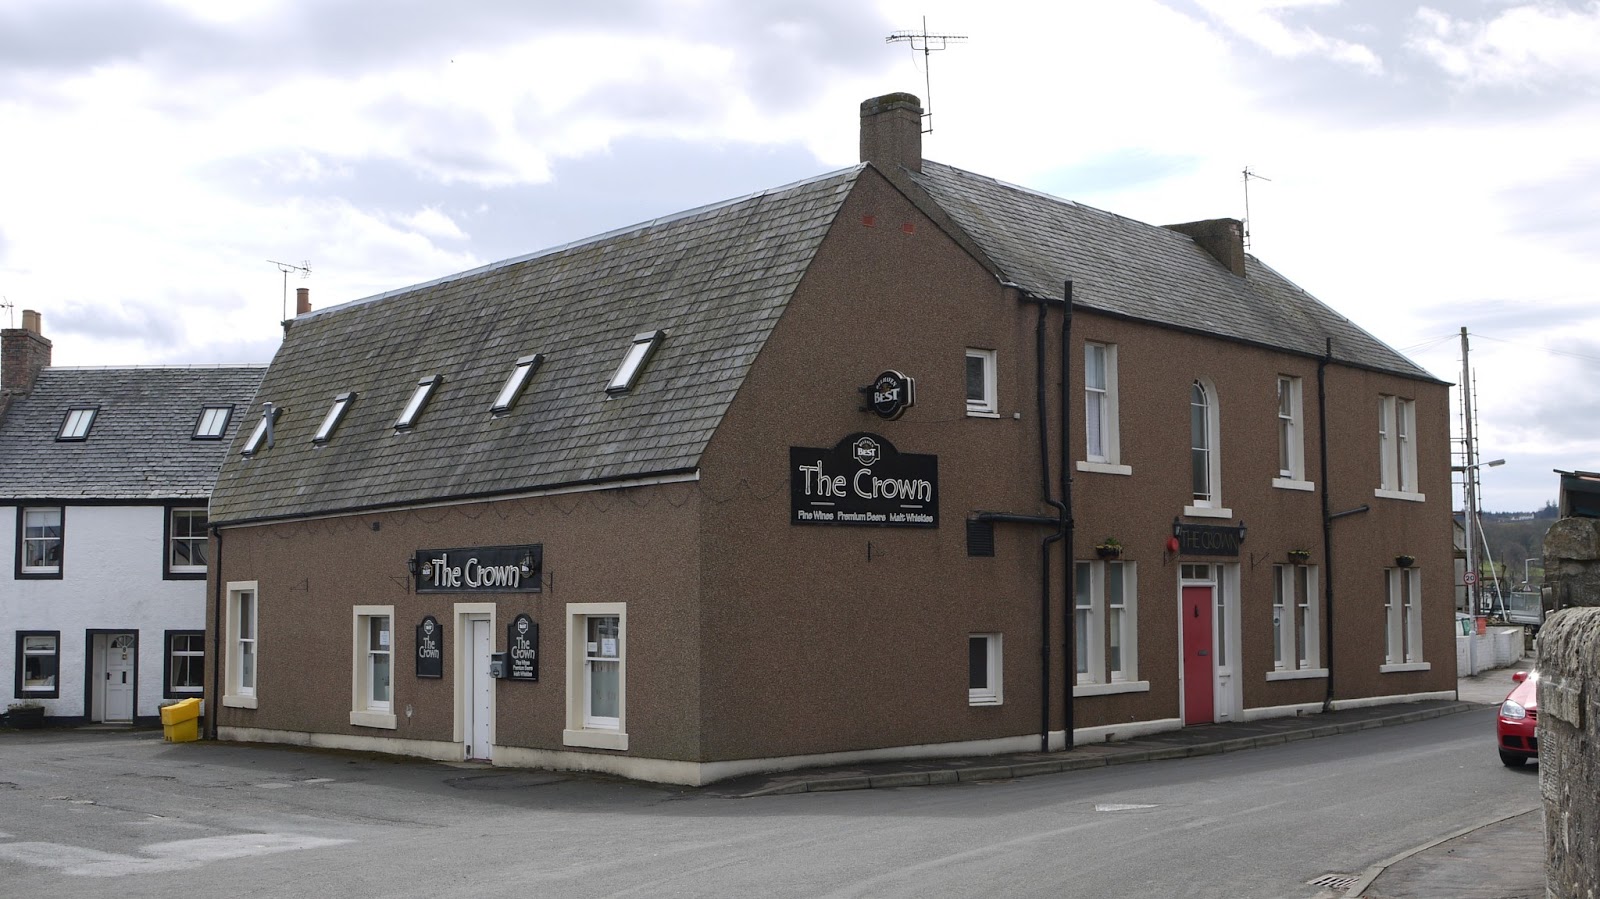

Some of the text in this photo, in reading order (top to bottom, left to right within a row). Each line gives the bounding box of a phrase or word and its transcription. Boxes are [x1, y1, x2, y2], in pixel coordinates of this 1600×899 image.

[874, 387, 900, 404] BEST
[857, 447, 876, 457] BEST
[799, 460, 932, 502] The Crown
[798, 510, 834, 520] Fine Wines
[837, 511, 886, 522] Premium Beers
[889, 512, 934, 523] Malt Whiskies
[1181, 529, 1238, 550] THE CROWN
[432, 553, 520, 589] The Crown
[423, 635, 436, 649] The
[516, 634, 530, 650] The
[419, 646, 440, 659] Crown
[511, 646, 536, 660] Crown
